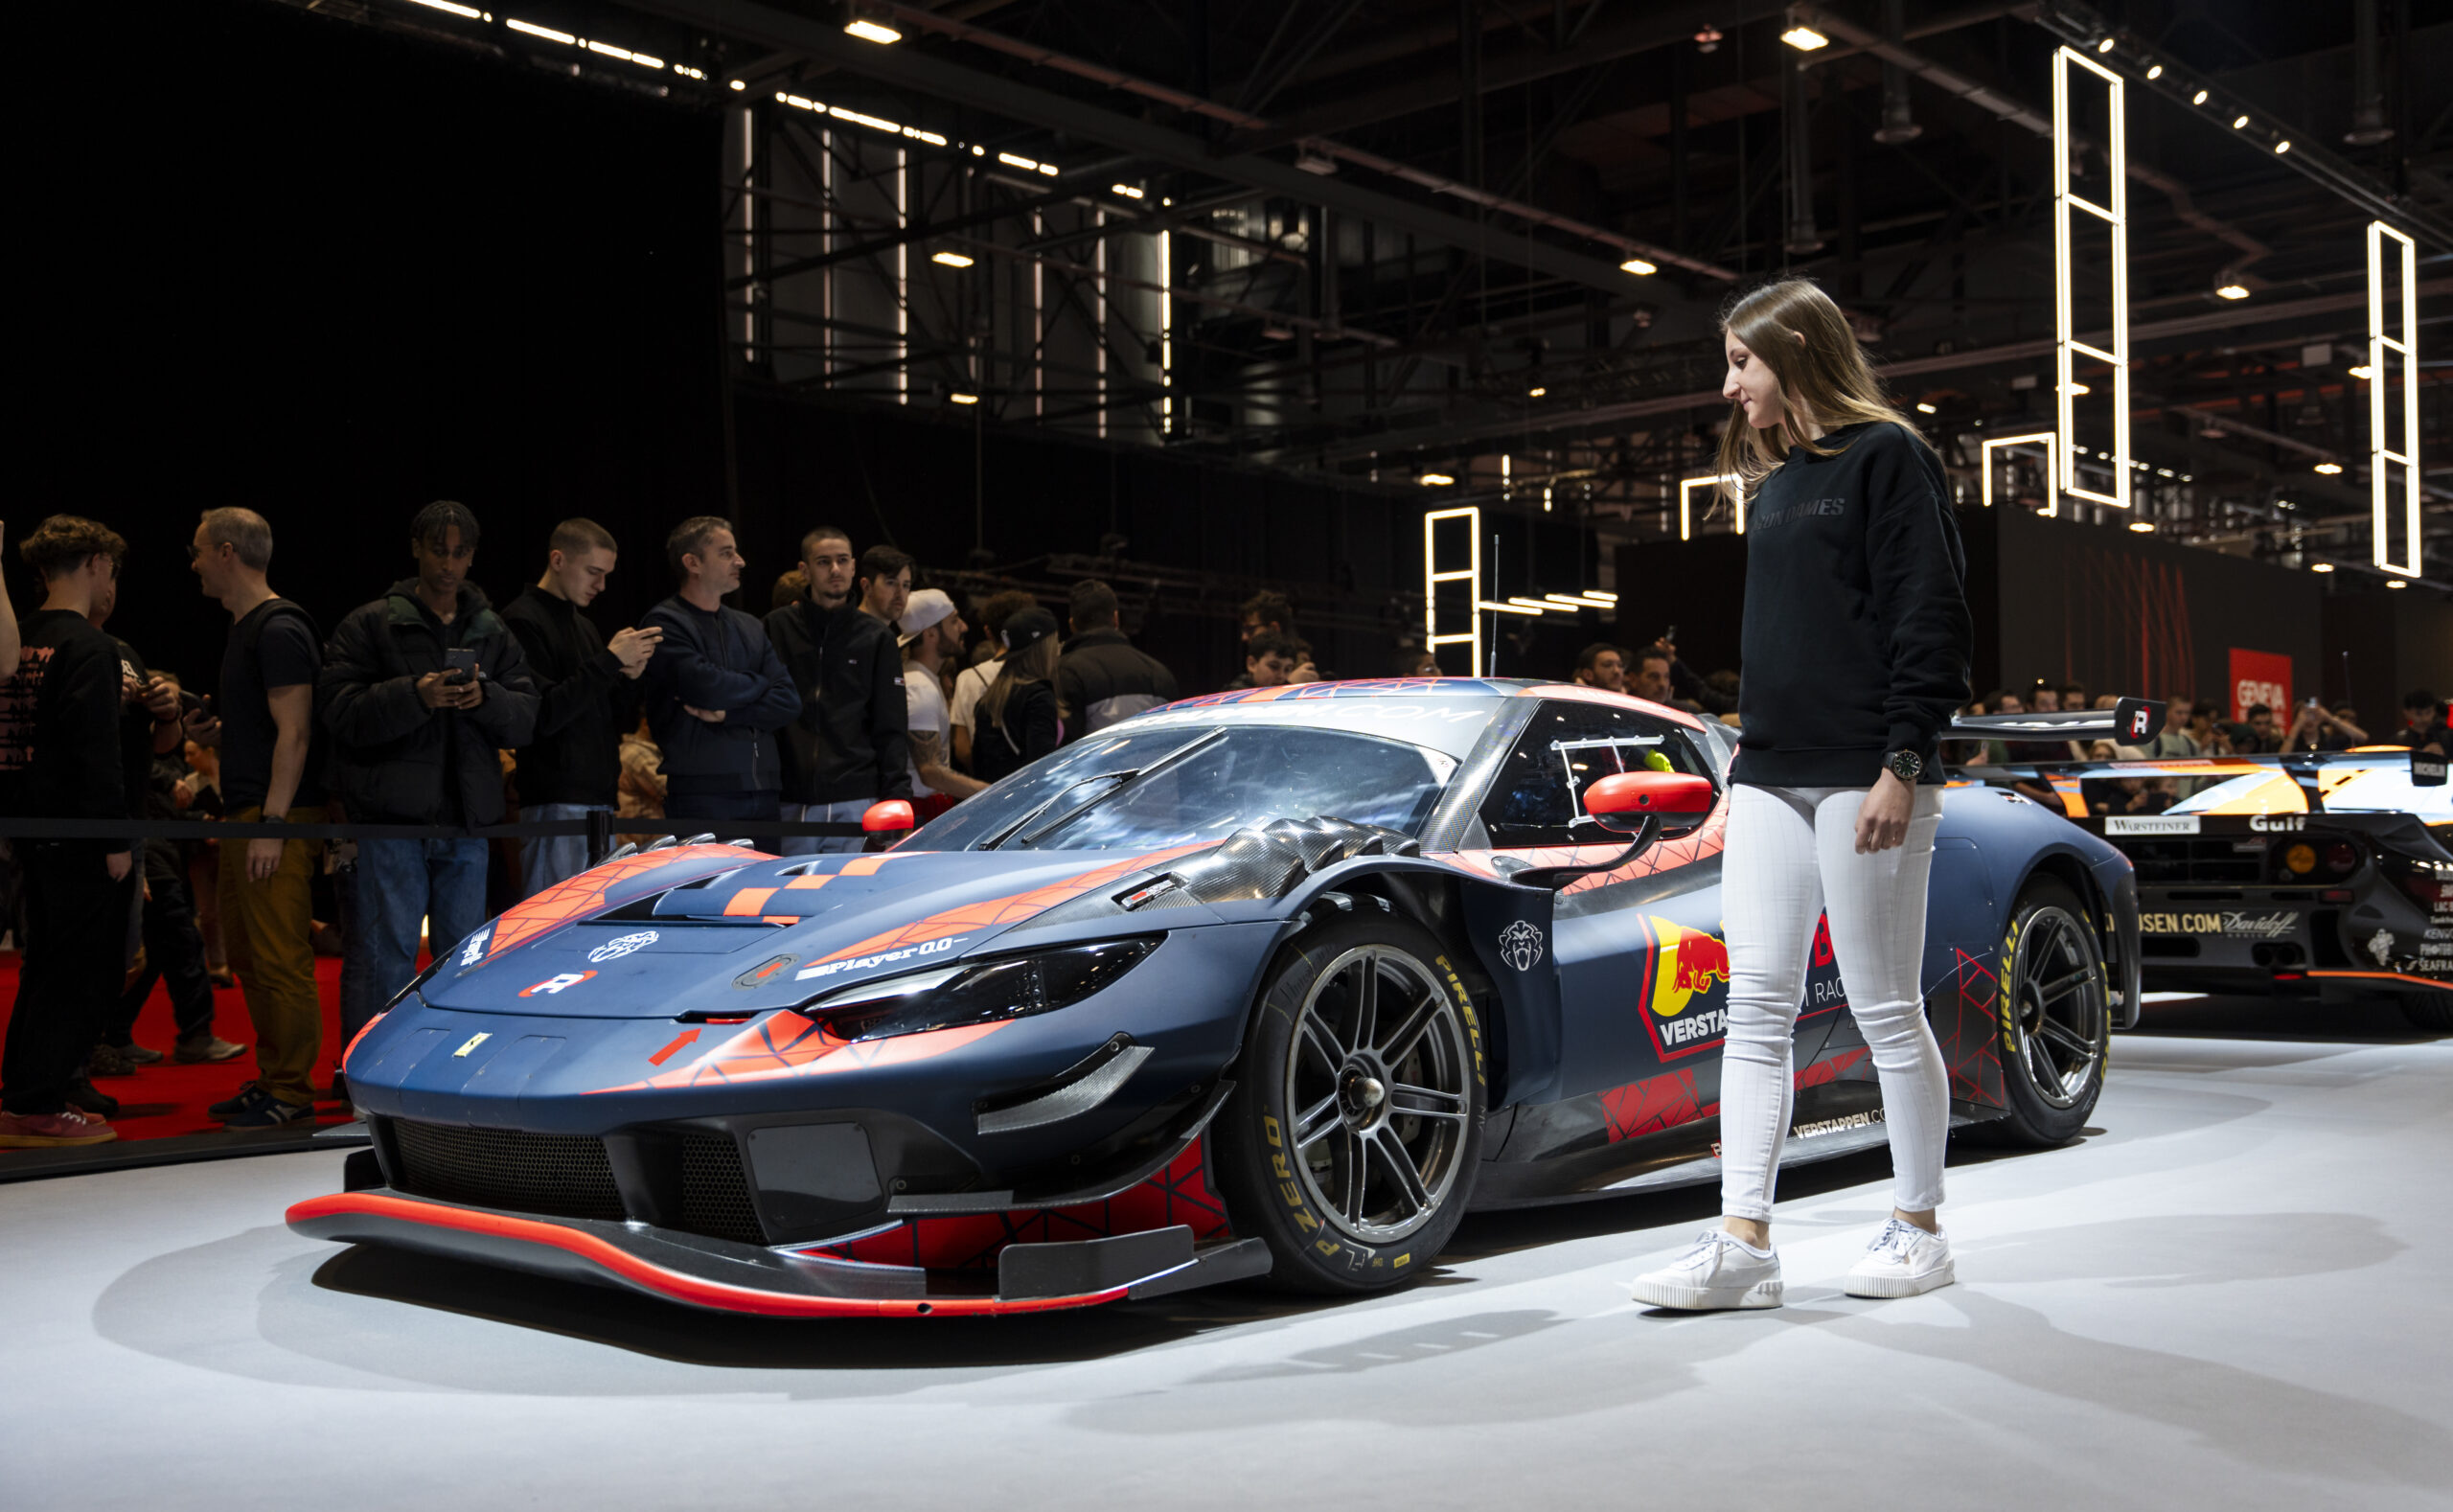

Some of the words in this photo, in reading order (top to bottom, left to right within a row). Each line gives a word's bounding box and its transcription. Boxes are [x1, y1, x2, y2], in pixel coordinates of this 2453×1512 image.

[1785, 497, 1845, 523] DAMES
[2114, 819, 2189, 832] WARSTEINER
[2250, 814, 2305, 831] Gulf
[2221, 911, 2299, 937] Davidoff
[828, 948, 919, 975] Player
[2000, 919, 2019, 1052] PIRELLI
[1436, 954, 1485, 1087] PIRELLI
[1660, 1008, 1729, 1046] VERSTA
[1263, 1116, 1318, 1233] ZERO
